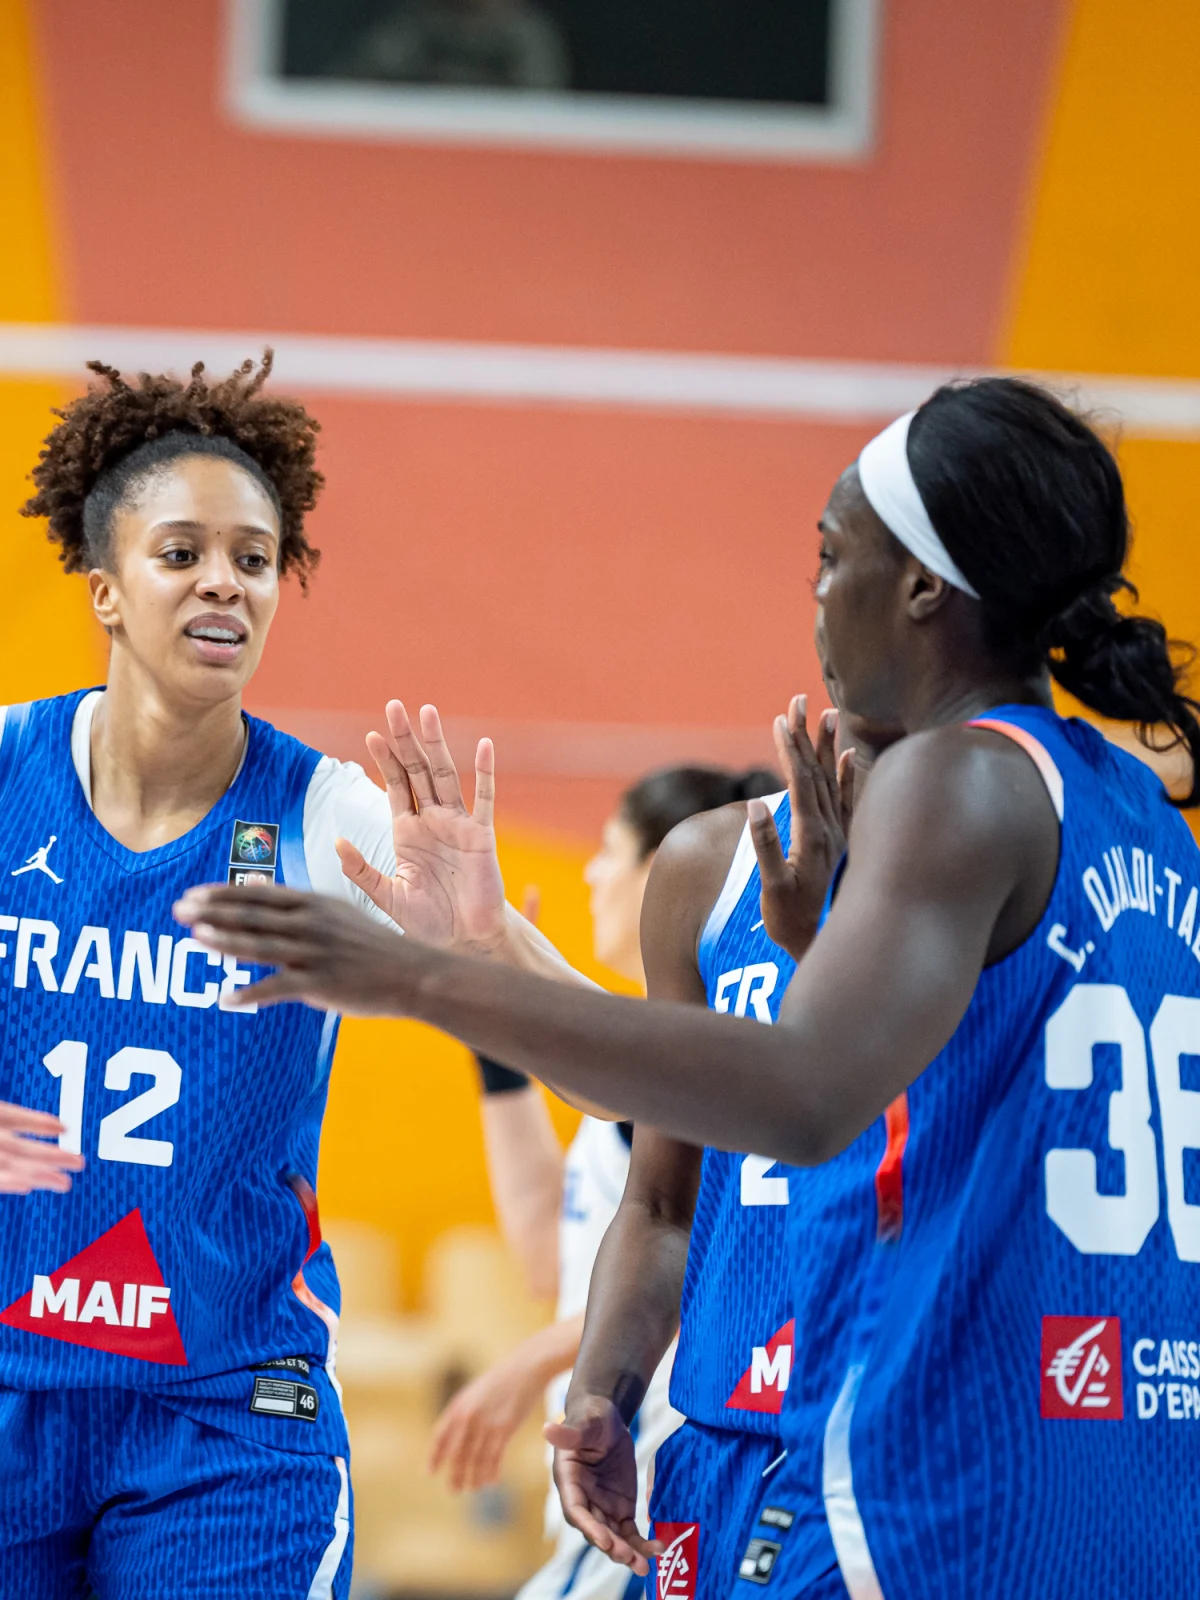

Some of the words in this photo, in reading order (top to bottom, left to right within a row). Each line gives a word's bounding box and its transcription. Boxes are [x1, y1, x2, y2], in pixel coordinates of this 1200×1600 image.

[1046, 923, 1096, 974] C.
[1082, 845, 1200, 963] DJALDI-TA
[42, 1039, 183, 1168] 12
[29, 1274, 171, 1329] MAIF
[1132, 1337, 1200, 1380] CAISS
[299, 1394, 315, 1410] 46
